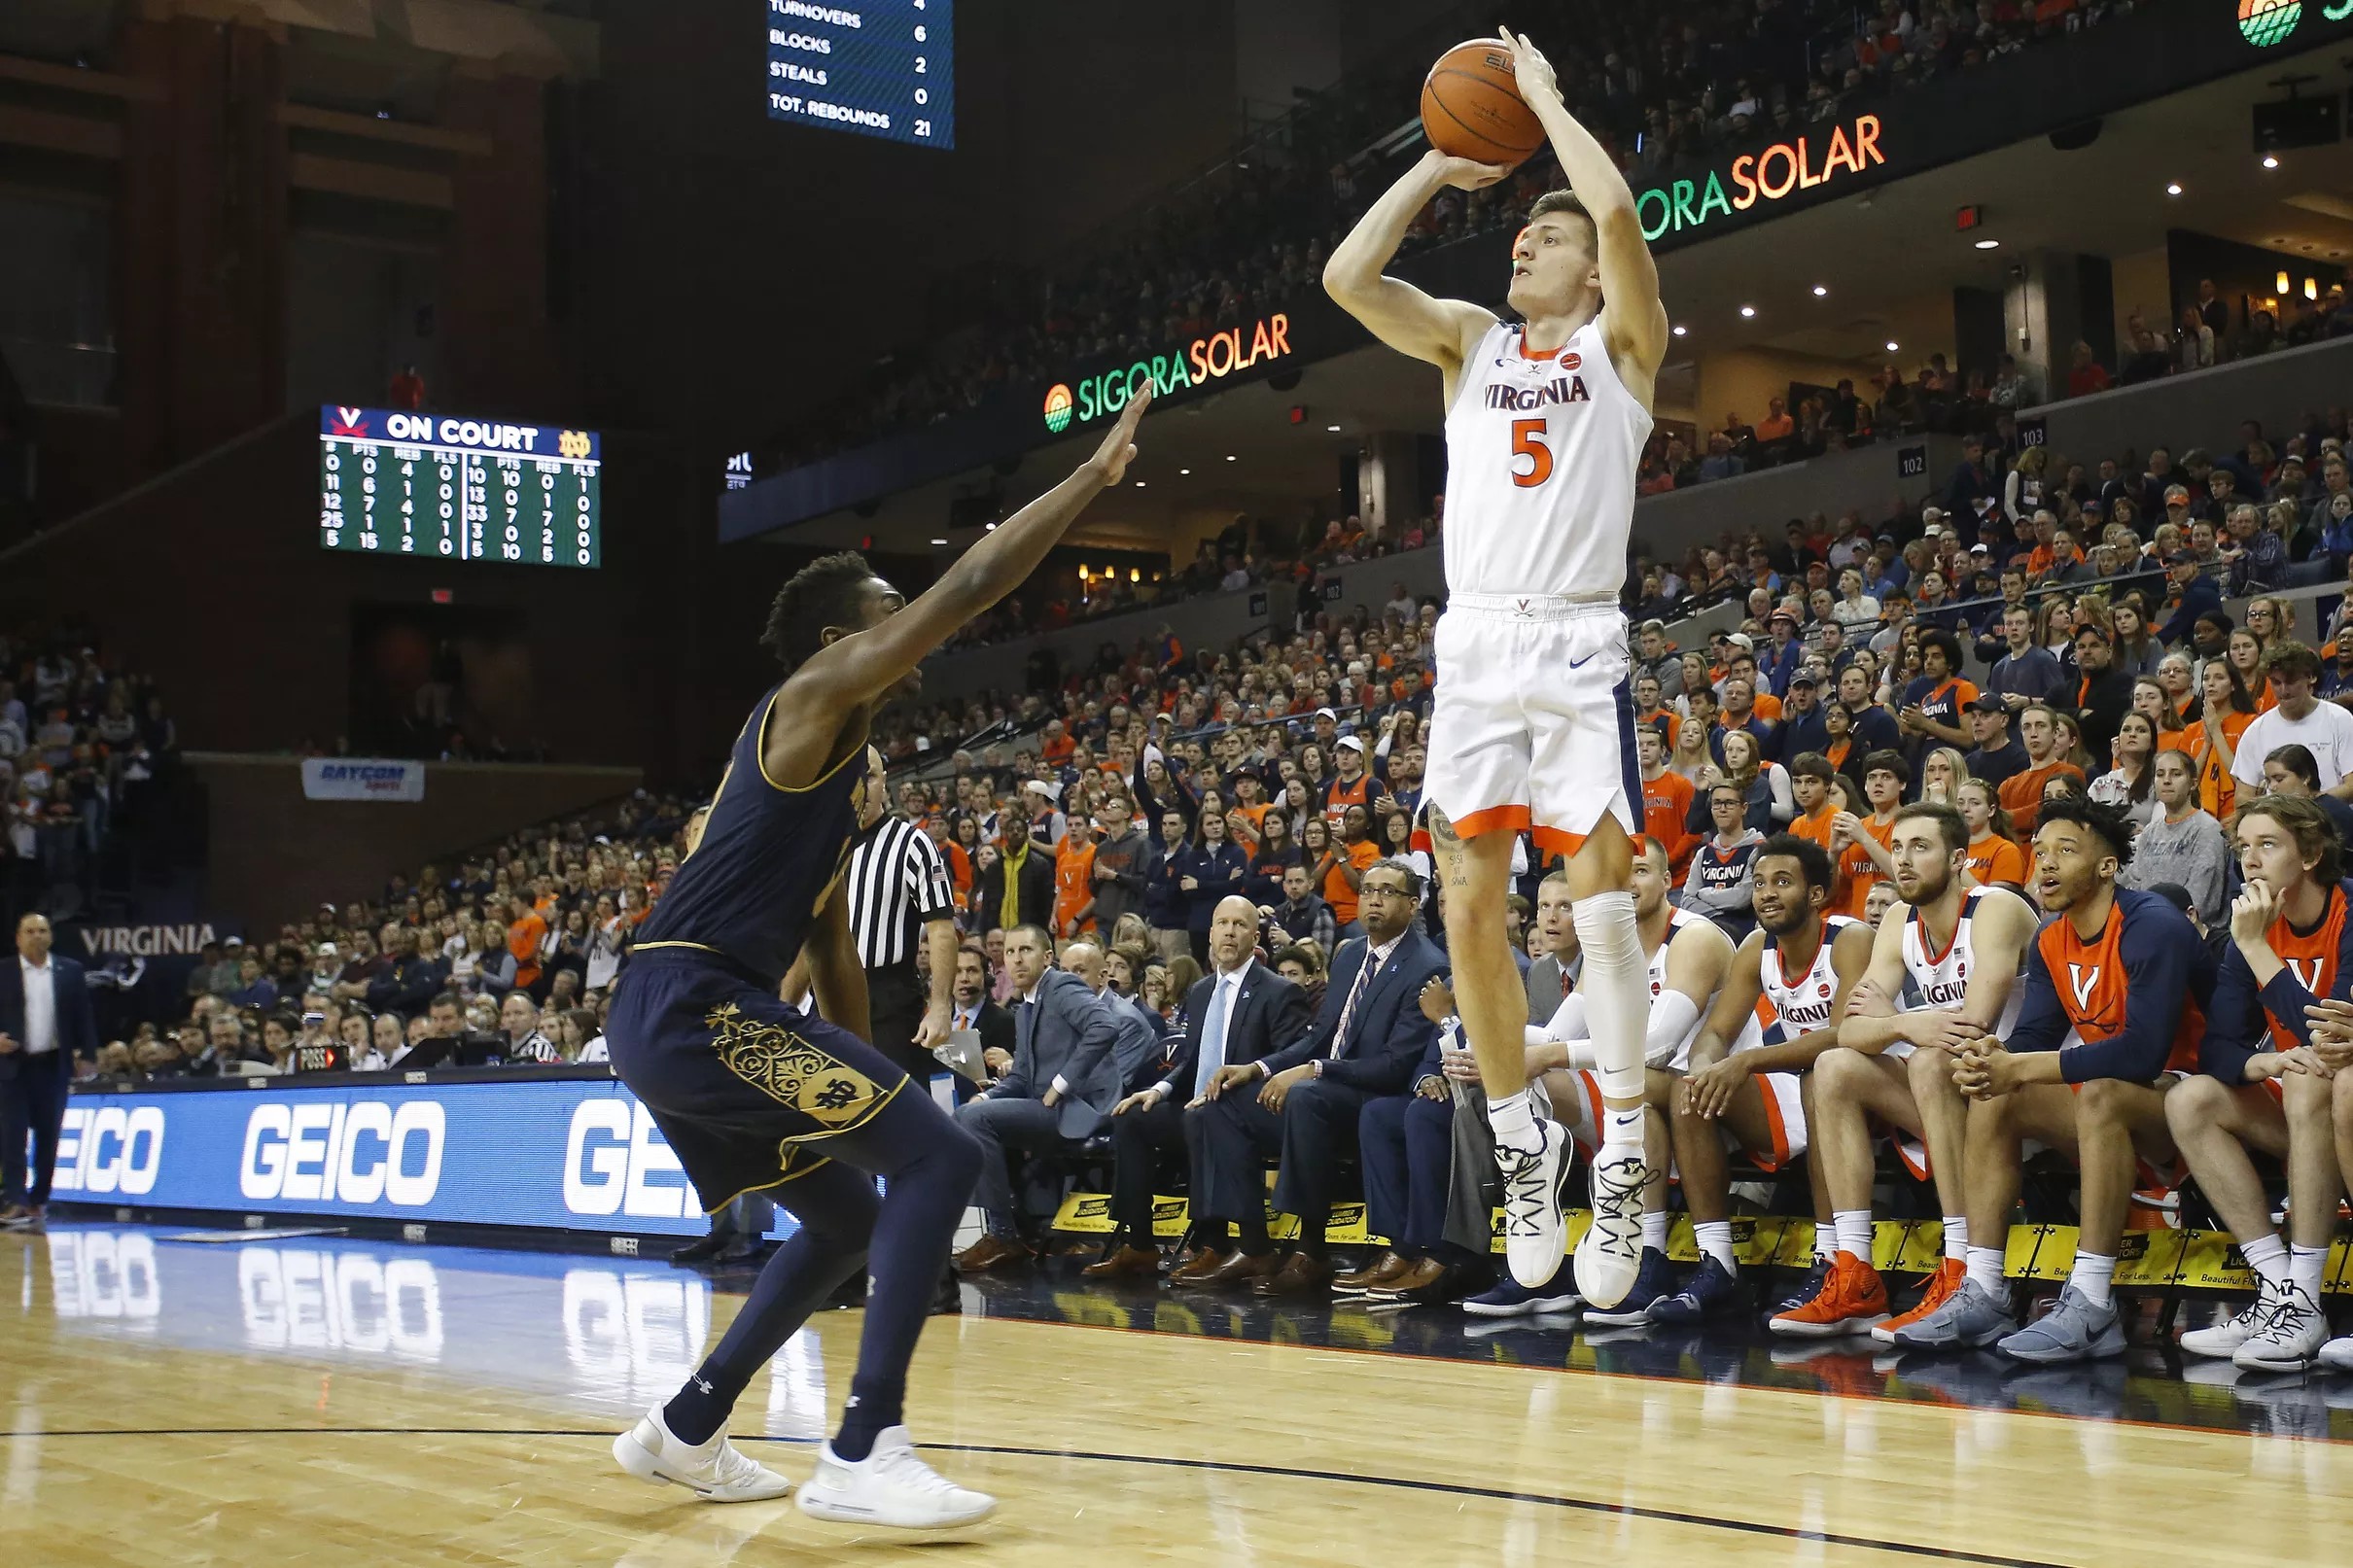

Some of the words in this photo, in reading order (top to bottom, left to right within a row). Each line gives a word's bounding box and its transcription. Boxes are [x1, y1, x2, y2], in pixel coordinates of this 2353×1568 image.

[769, 0, 861, 29] TURNOVERS
[913, 25, 927, 42] 6
[769, 28, 831, 54] BLOCKS
[914, 56, 927, 74] 2
[769, 60, 827, 86] STEALS
[914, 87, 928, 105] 0
[769, 92, 805, 114] TOT.
[807, 100, 891, 129] REBOUNDS
[913, 120, 931, 137] 21
[1485, 375, 1591, 411] VIRGINIA
[386, 413, 433, 442] ON
[439, 418, 539, 451] COURT
[2022, 428, 2043, 446] 103
[353, 443, 378, 457] PTS
[394, 447, 421, 462] REB
[434, 452, 458, 465] FLS
[497, 457, 521, 470] PTS
[536, 461, 561, 474] REB
[573, 465, 596, 477] FLS
[1511, 418, 1554, 488] 5
[1904, 457, 1922, 473] 102
[326, 456, 340, 471] 0
[363, 458, 376, 473] 0
[401, 462, 413, 477] 4
[439, 465, 453, 480] 0
[468, 467, 486, 483] 10
[502, 470, 520, 487] 10
[541, 474, 554, 490] 0
[580, 477, 587, 493] 1
[326, 473, 339, 490] 11
[404, 480, 411, 497] 1
[439, 484, 453, 500] 0
[469, 486, 486, 503] 13
[505, 489, 518, 505] 0
[544, 493, 551, 508] 1
[578, 496, 591, 511] 0
[321, 511, 343, 528] 25
[365, 514, 373, 531] 1
[404, 517, 411, 533] 1
[442, 520, 450, 537] 1
[472, 523, 483, 540] 3
[505, 526, 518, 542] 0
[542, 529, 553, 544] 2
[578, 532, 591, 547] 0
[323, 493, 341, 509] 12
[363, 496, 376, 512] 7
[401, 500, 413, 515] 4
[439, 502, 453, 518] 0
[468, 505, 488, 521] 33
[506, 507, 517, 524] 7
[543, 510, 553, 527] 7
[578, 514, 591, 530] 0
[327, 530, 339, 546] 5
[360, 532, 378, 549] 15
[402, 536, 414, 552] 2
[439, 539, 453, 555] 0
[472, 540, 483, 557] 5
[501, 543, 520, 560] 10
[542, 546, 553, 563] 5
[578, 549, 591, 566] 0
[80, 923, 216, 957] VIRGINIA
[25, 1106, 165, 1195] EICO
[239, 1100, 446, 1206] GEICO
[2201, 1273, 2240, 1285] Beautiful
